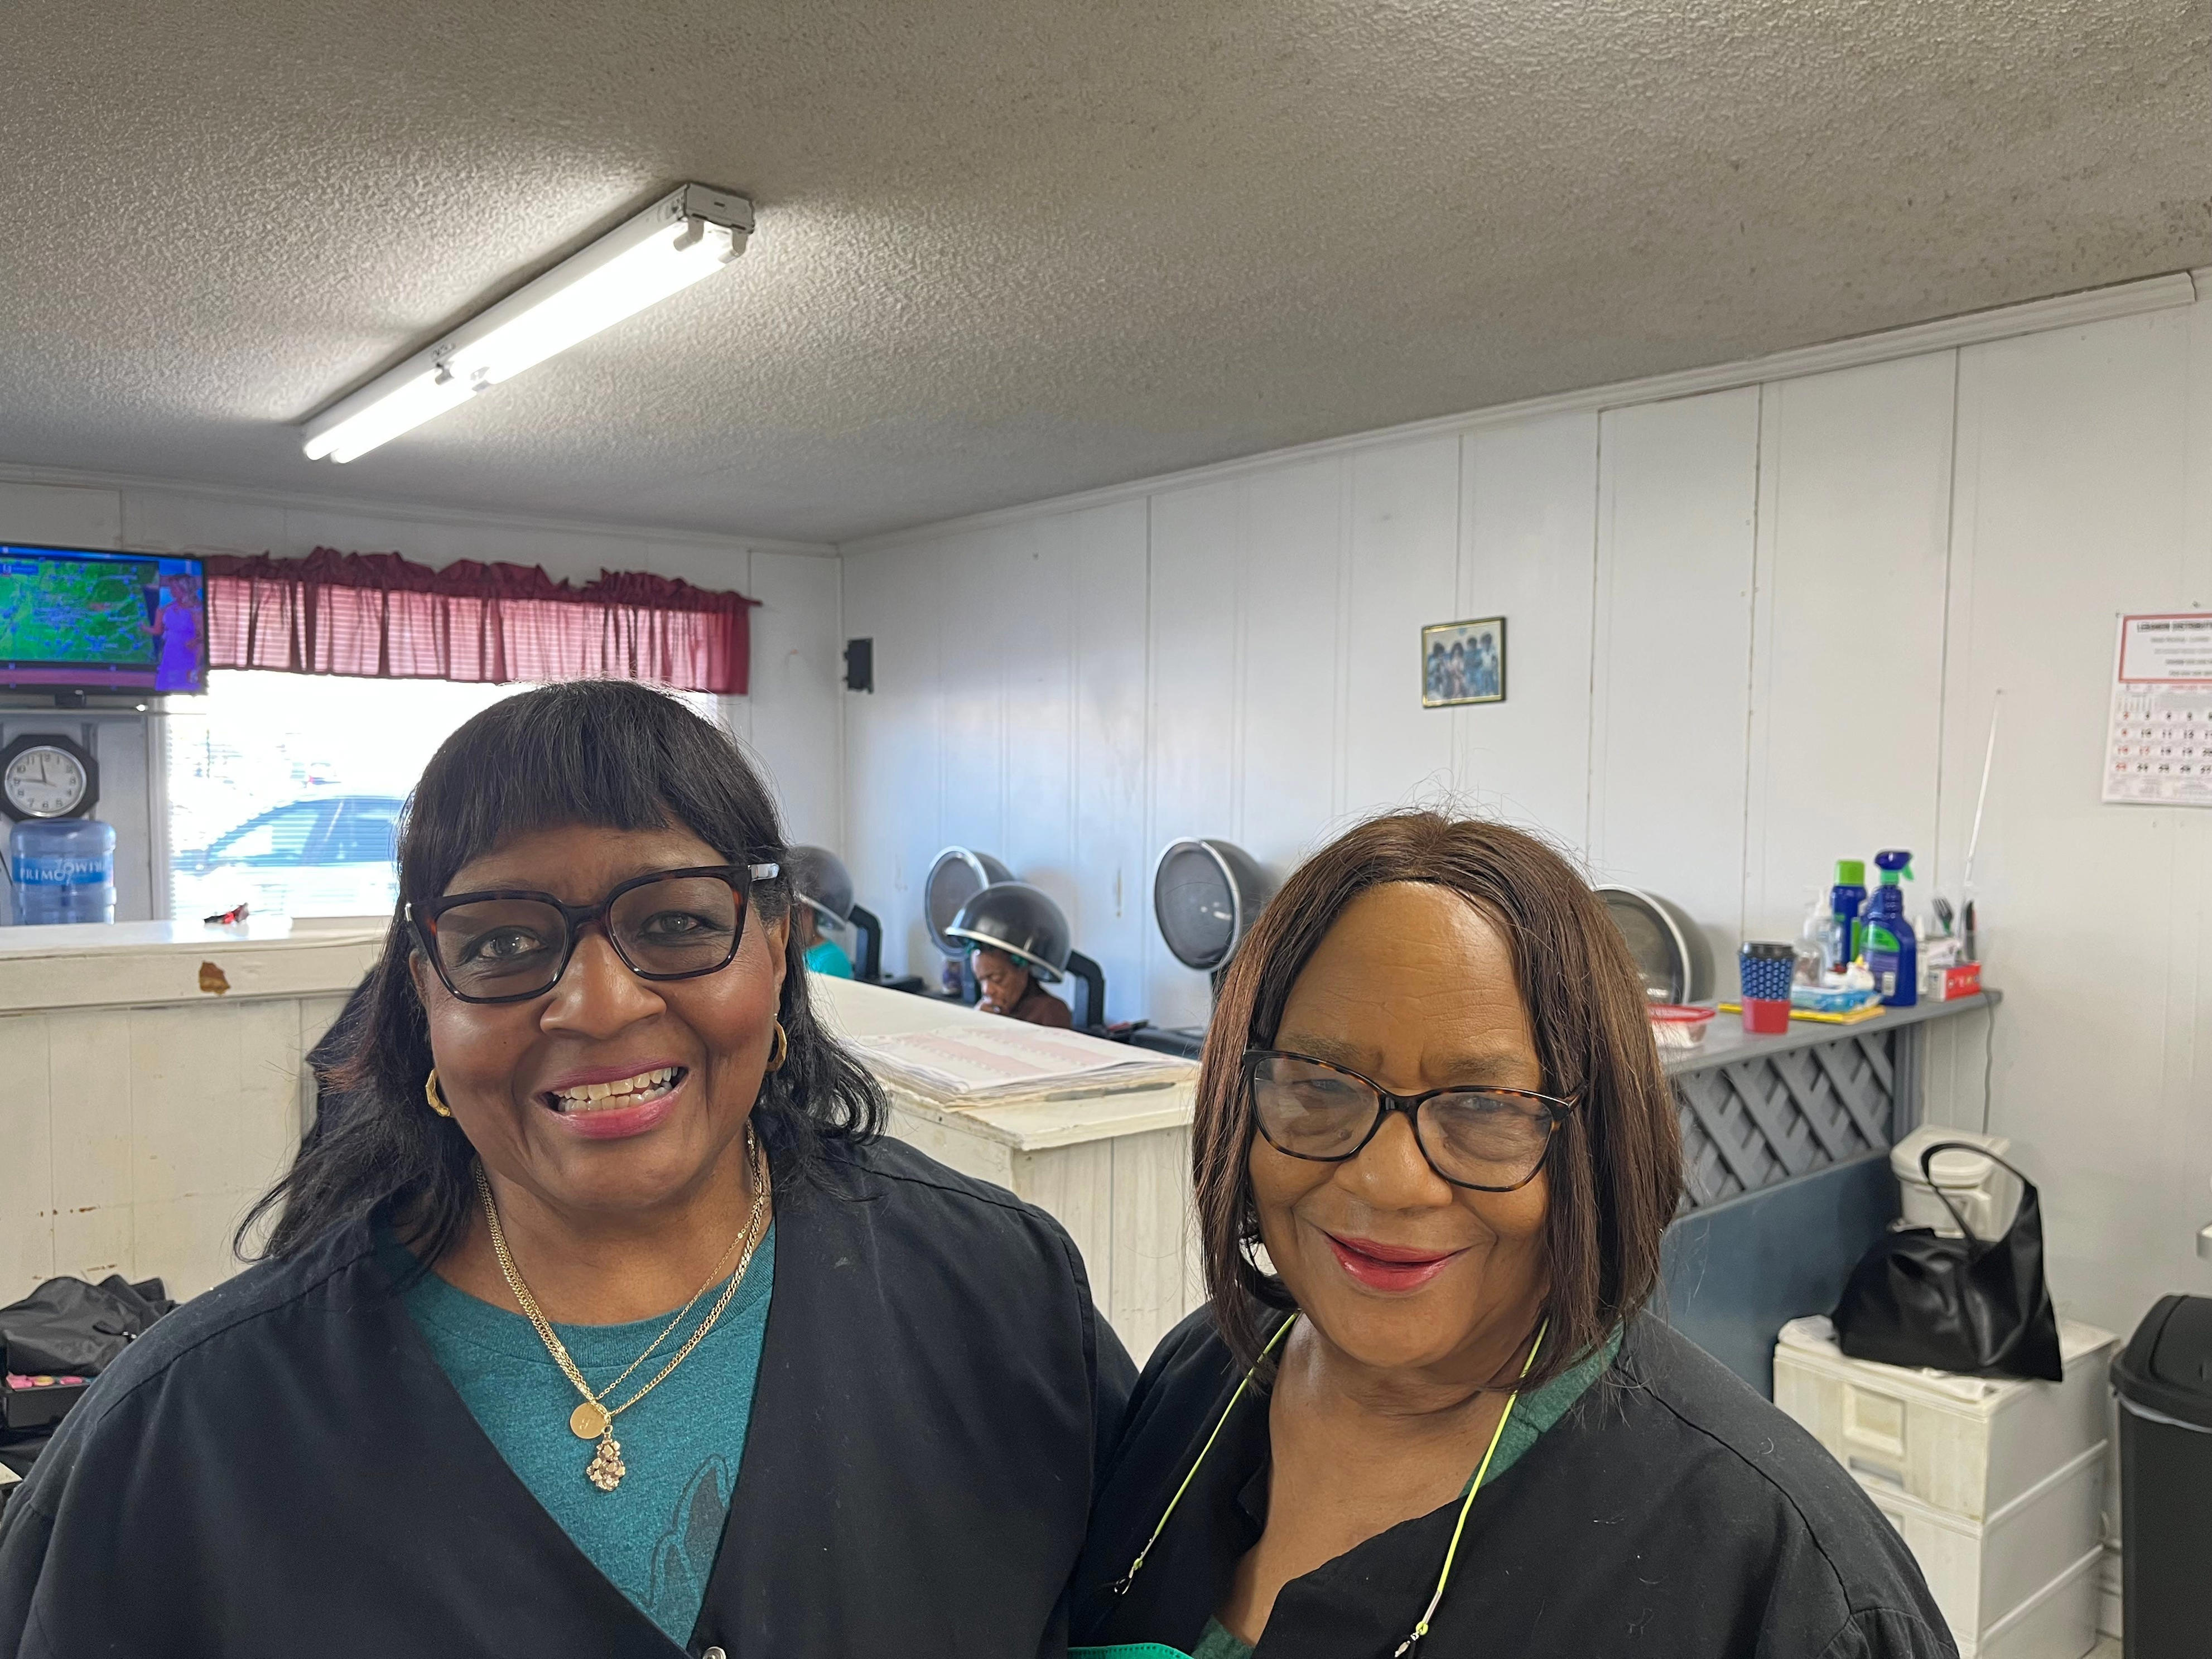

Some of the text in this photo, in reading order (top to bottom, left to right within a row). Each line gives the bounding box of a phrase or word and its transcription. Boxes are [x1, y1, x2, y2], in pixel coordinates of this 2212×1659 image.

[26, 754, 35, 765] 11
[17, 764, 26, 773] 10
[27, 798, 35, 808] 7
[42, 800, 49, 809] 6
[20, 867, 66, 881] PRIMO
